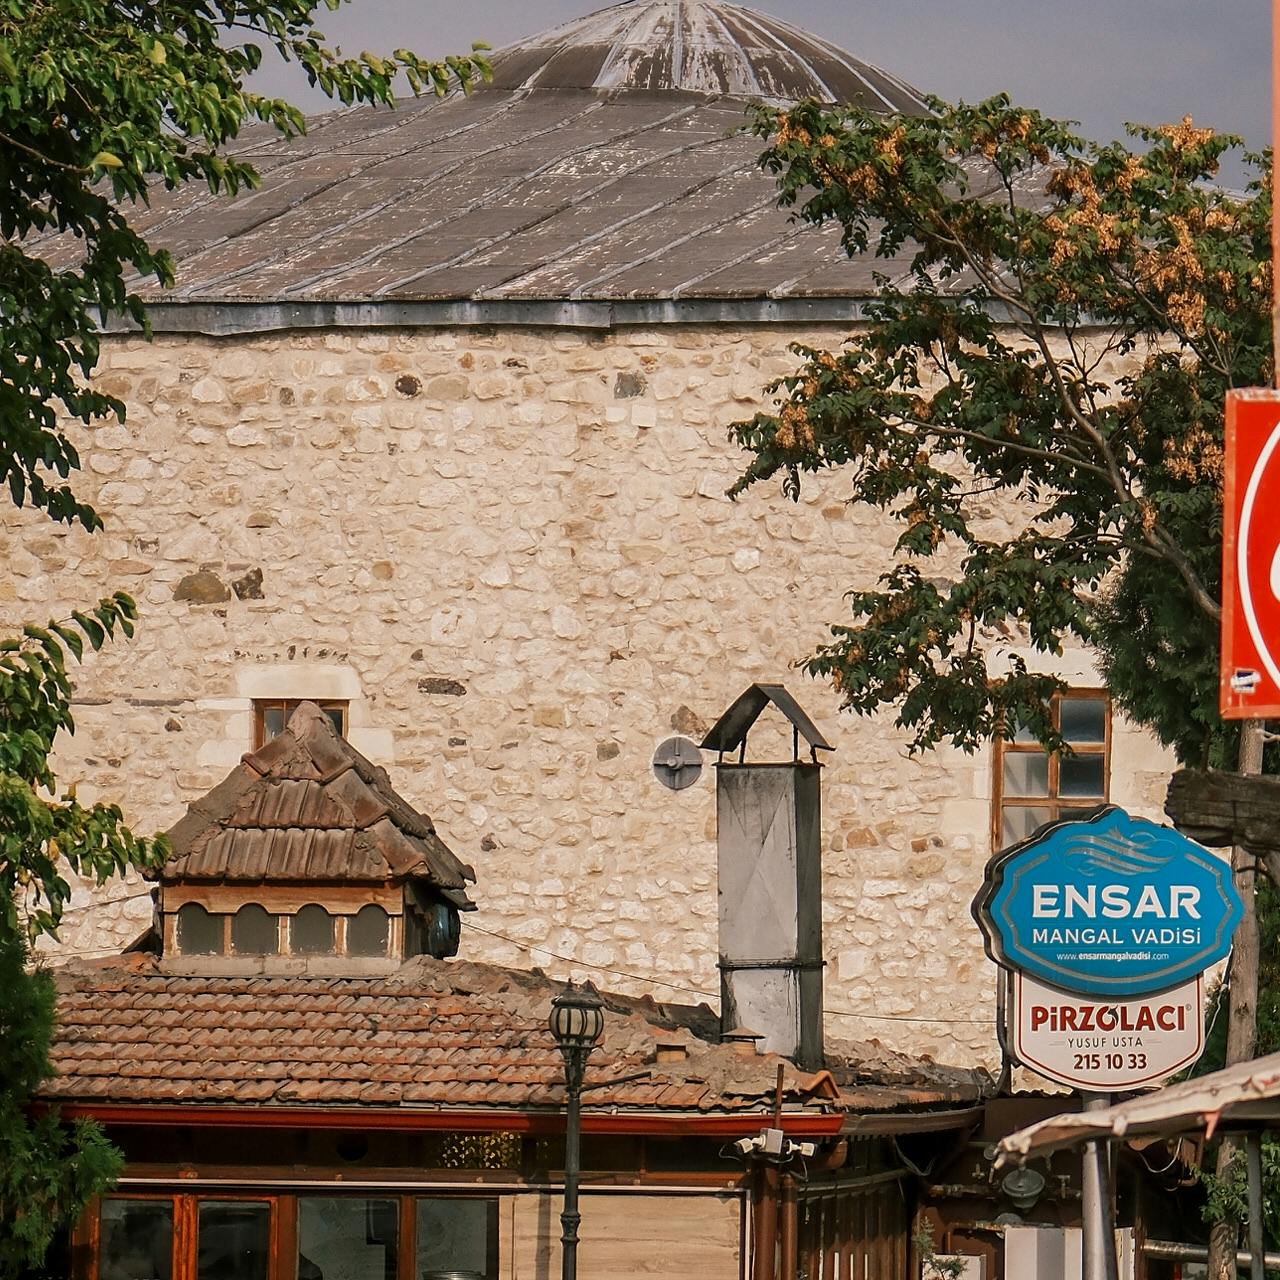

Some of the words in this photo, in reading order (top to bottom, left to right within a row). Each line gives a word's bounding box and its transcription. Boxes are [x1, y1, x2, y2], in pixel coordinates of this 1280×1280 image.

[1032, 884, 1201, 919] ENSAR
[1032, 928, 1124, 944] MANGAL
[1068, 1037, 1107, 1048] YUSUF
[1112, 1037, 1143, 1047] USTA
[1073, 1054, 1100, 1069] 215
[1105, 1054, 1123, 1069] 10
[1127, 1054, 1147, 1069] 33
